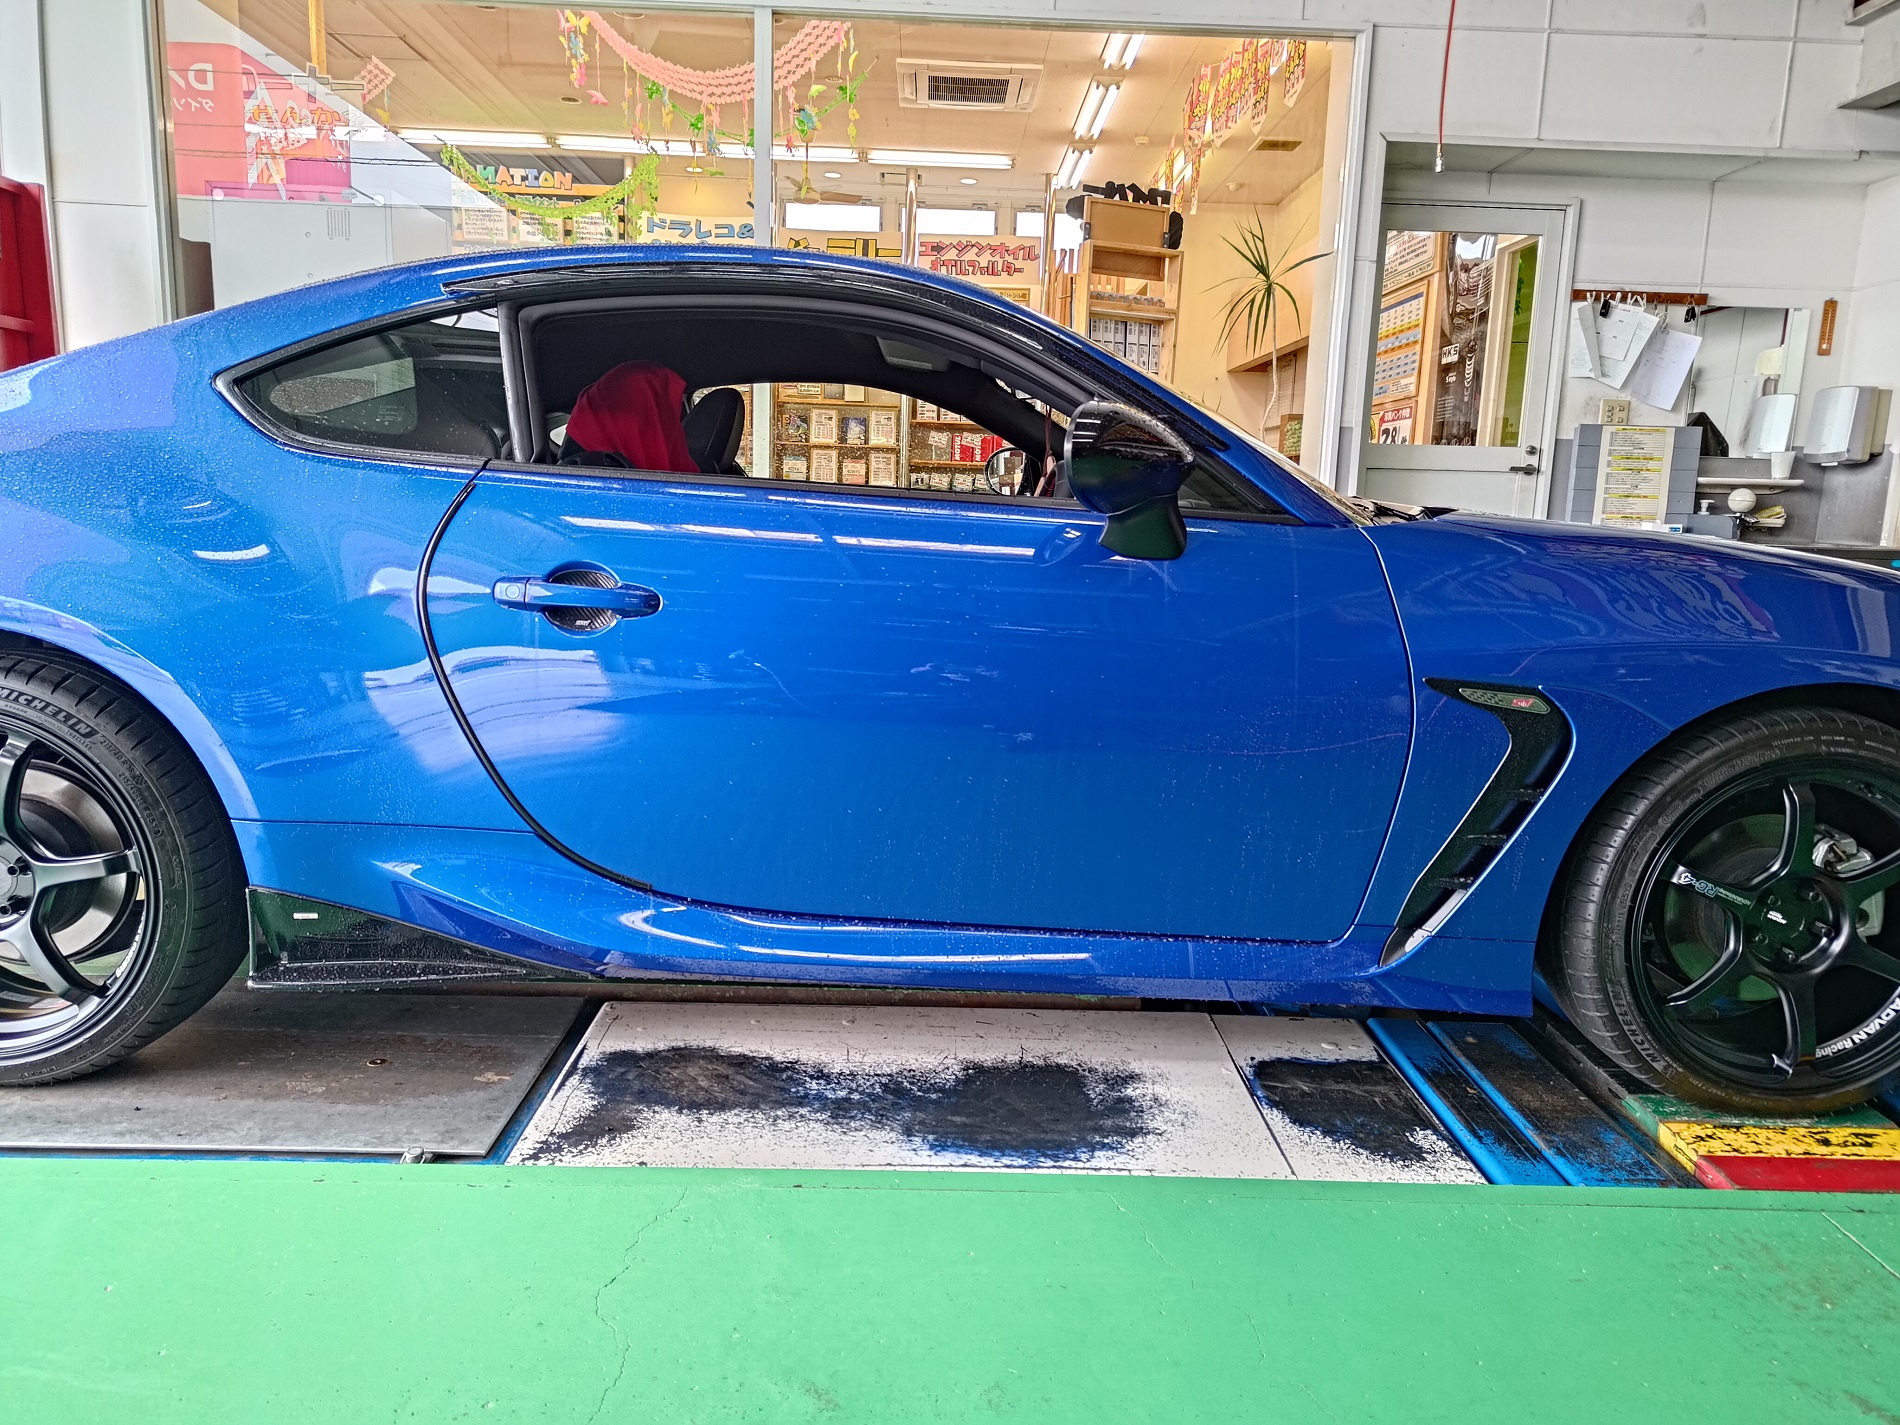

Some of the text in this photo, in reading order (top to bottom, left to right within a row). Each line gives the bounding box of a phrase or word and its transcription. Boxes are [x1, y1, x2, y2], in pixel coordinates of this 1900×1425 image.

[919, 240, 1040, 261] エンジンオイル
[930, 257, 1024, 276] オイルフィルター
[1442, 345, 1459, 360] HKS
[954, 435, 962, 461] MOTUL
[1609, 986, 1665, 1069] MICHELIN
[1815, 998, 1900, 1058] ADVAN Racing
